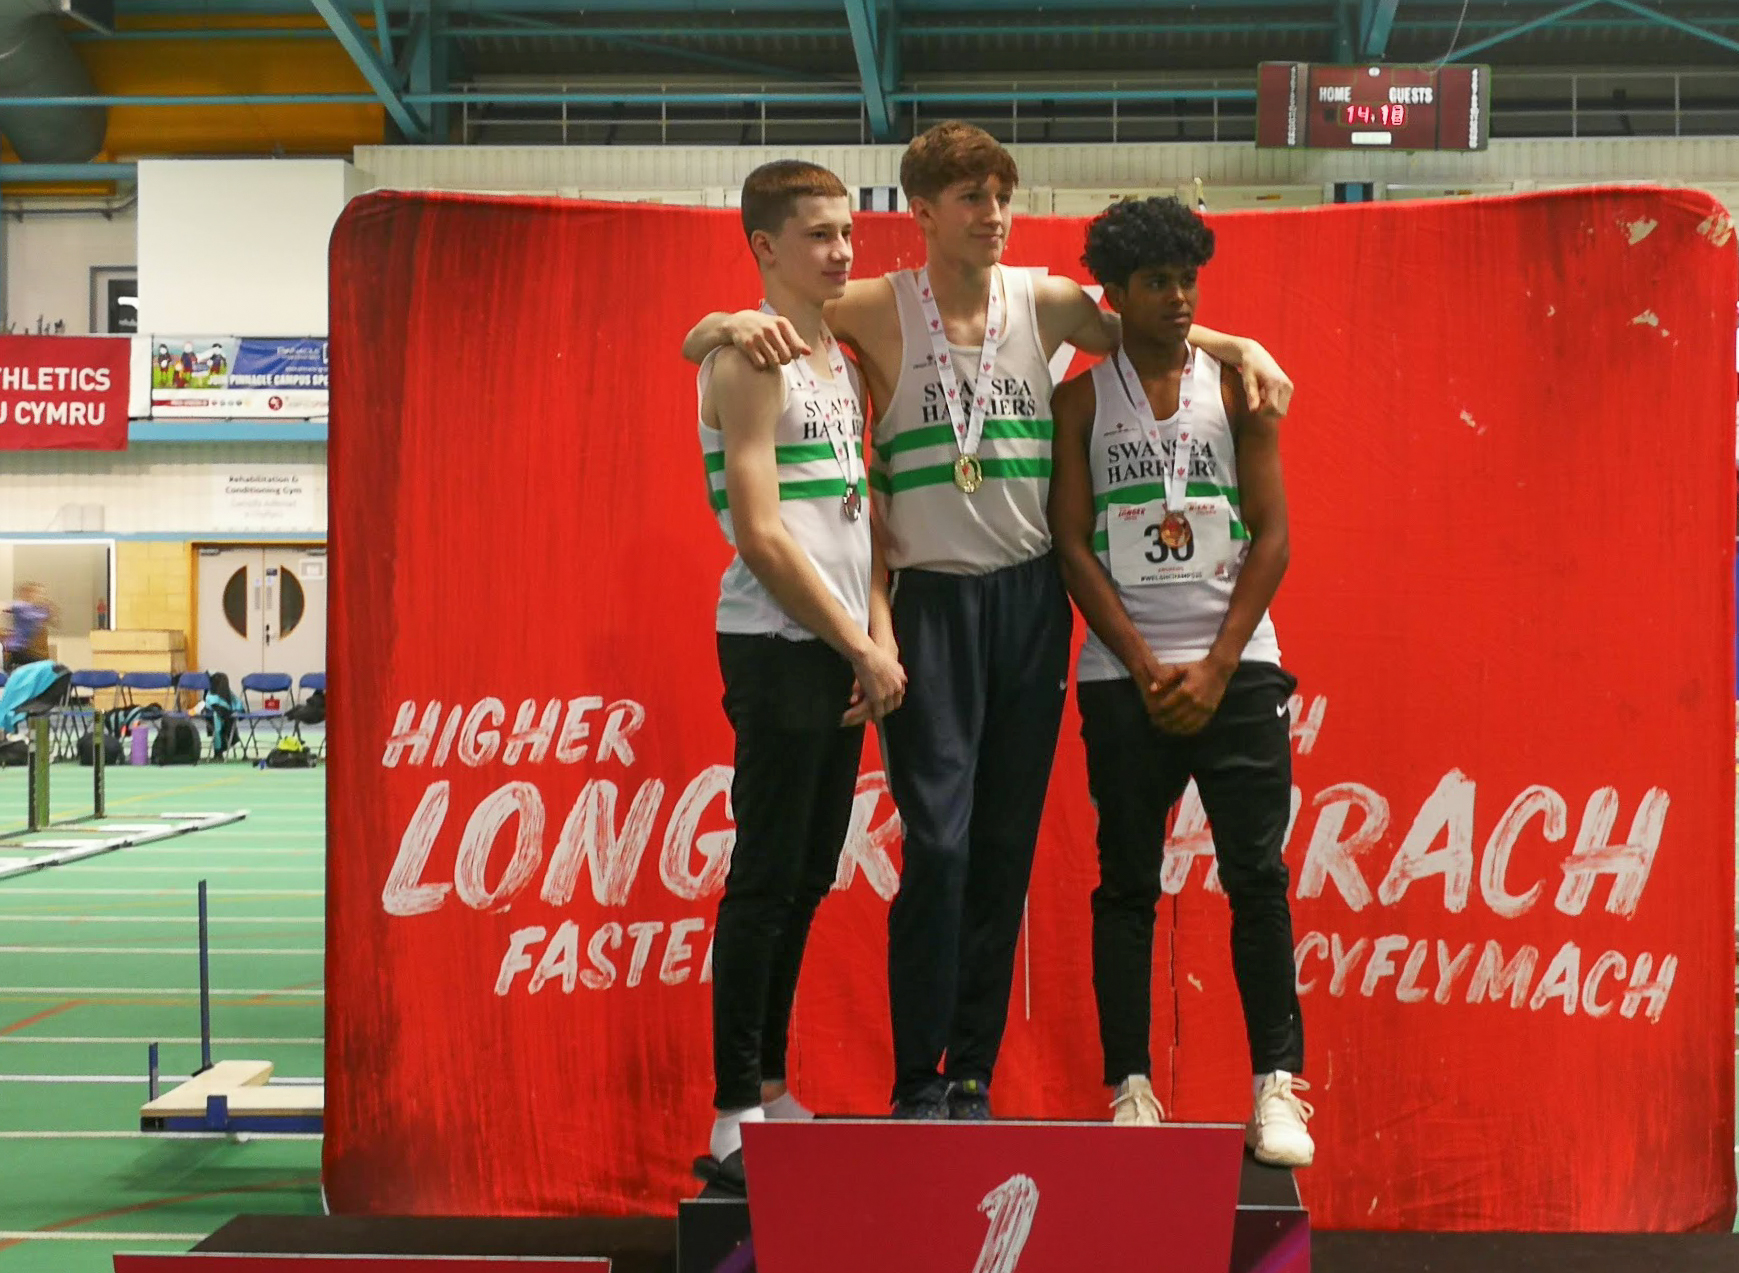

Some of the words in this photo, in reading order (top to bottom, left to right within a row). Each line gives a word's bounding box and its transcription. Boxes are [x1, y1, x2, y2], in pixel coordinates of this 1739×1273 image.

[1319, 86, 1352, 103] HOME
[1388, 86, 1434, 104] GUESTS
[0, 366, 112, 392] HLETICS
[229, 374, 273, 386] PINNACLE
[273, 374, 311, 386] CAMPUS
[14, 401, 106, 426] CYMRU
[1143, 523, 1195, 564] 30
[382, 695, 645, 769] HIGHER
[1295, 931, 1678, 1025] CYFLYMACH
[972, 1172, 1040, 1273] 1
